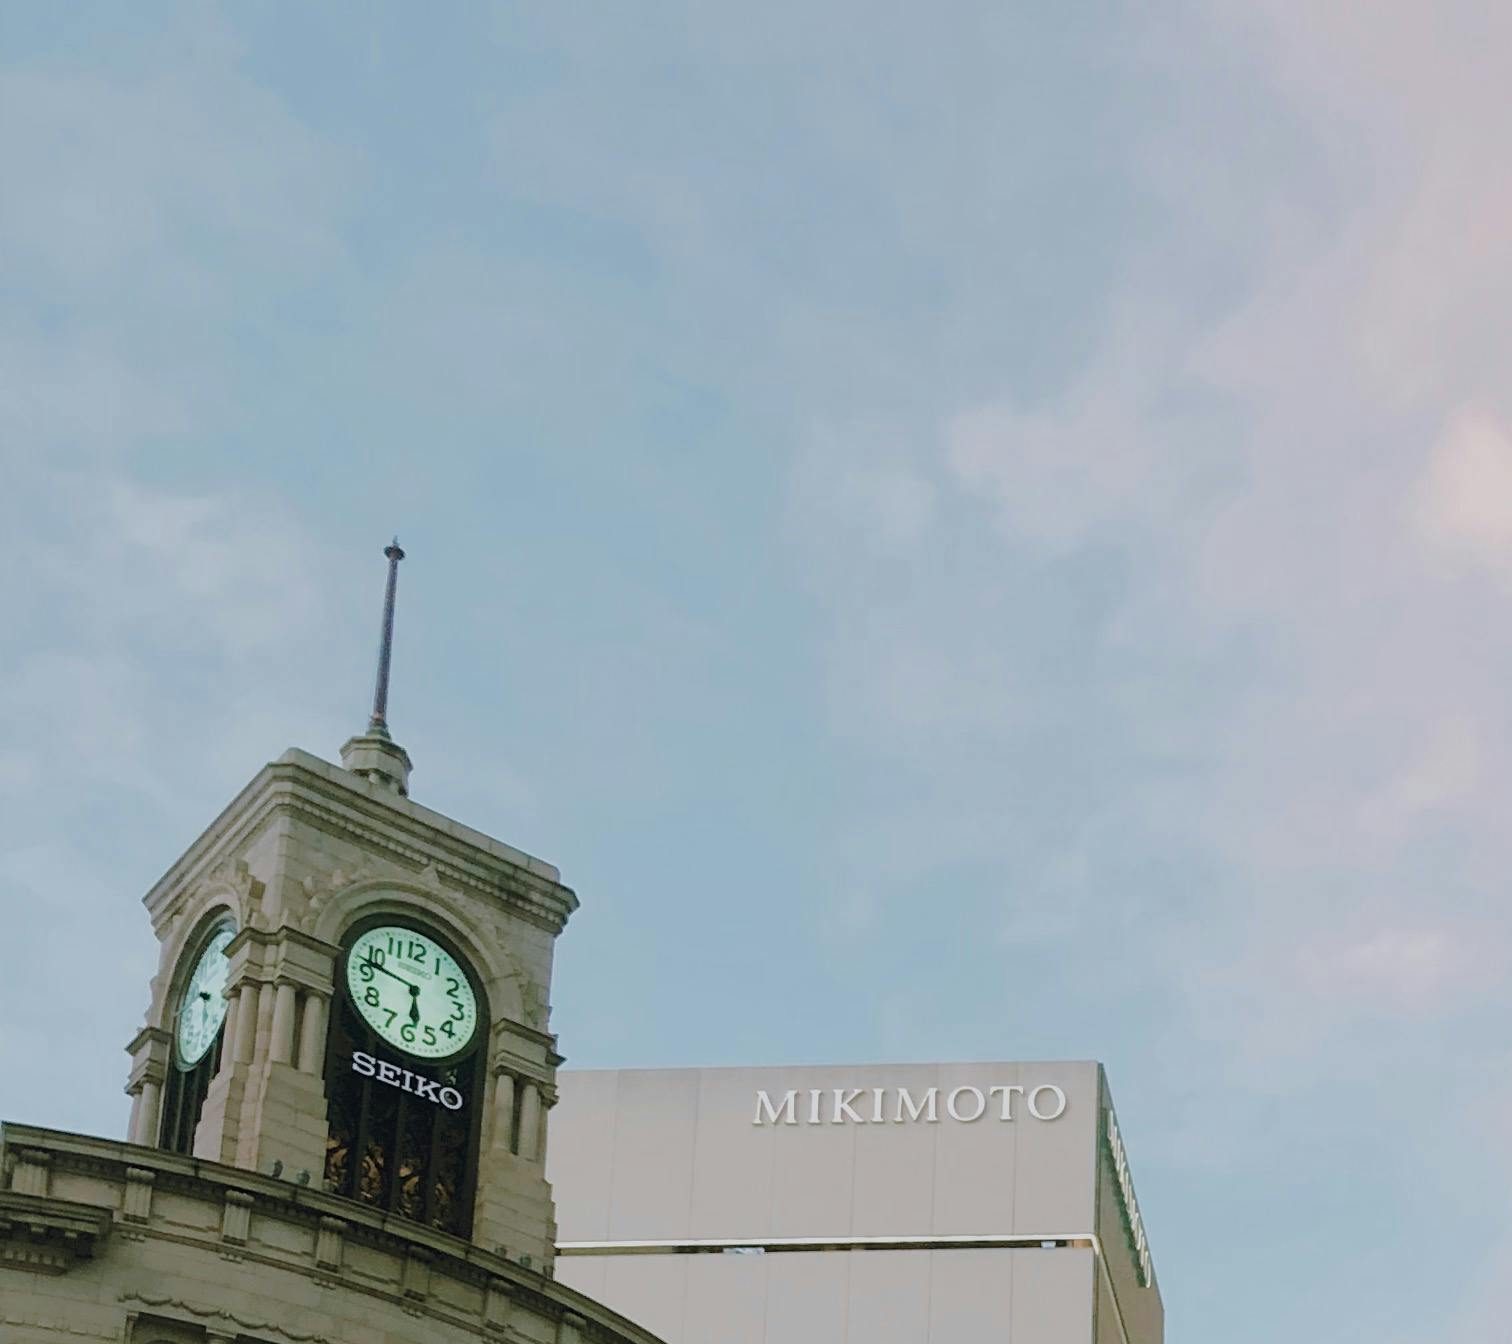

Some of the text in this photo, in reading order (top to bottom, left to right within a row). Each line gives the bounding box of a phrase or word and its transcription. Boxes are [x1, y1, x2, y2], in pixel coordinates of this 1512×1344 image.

[369, 945, 386, 968] 10
[388, 937, 402, 959] 11
[408, 941, 427, 963] 12
[360, 963, 374, 982] 9
[365, 987, 380, 1007] 8
[447, 978, 459, 998] 2
[382, 1008, 398, 1028] 7
[451, 1001, 464, 1021] 3
[401, 1023, 417, 1043] 6
[423, 1026, 436, 1046] 5
[440, 1020, 455, 1039] 4
[353, 1051, 463, 1110] SEIKO
[752, 1084, 1066, 1125] MIKIMOTO
